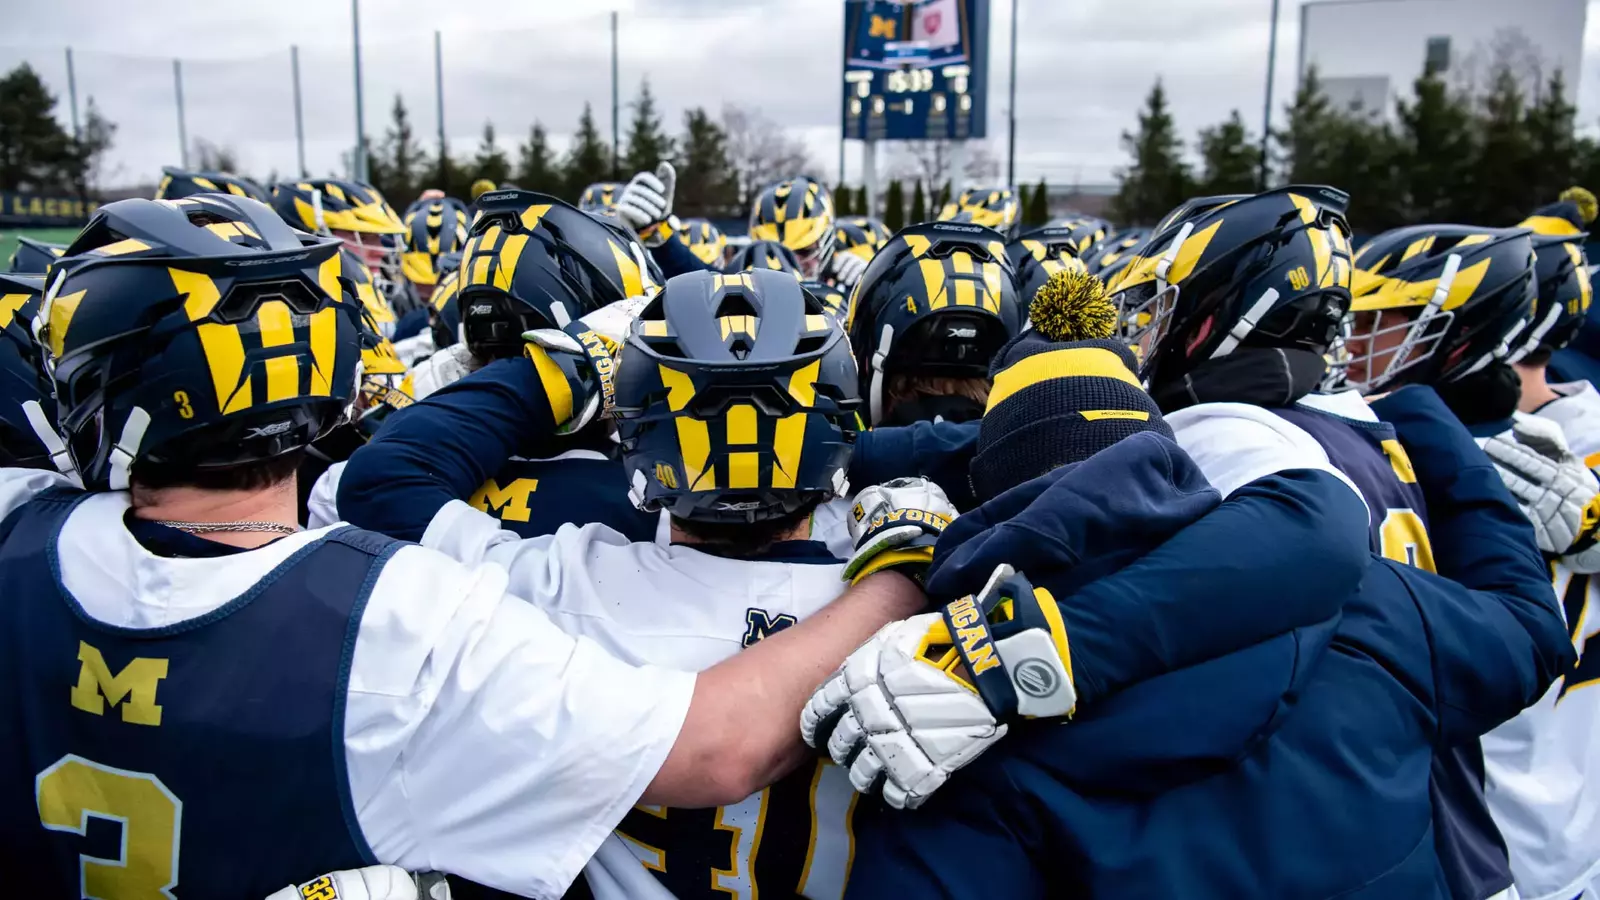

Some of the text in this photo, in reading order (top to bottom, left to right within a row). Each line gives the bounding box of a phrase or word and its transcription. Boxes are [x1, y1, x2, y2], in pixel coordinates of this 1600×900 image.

[933, 223, 983, 234] cascade
[906, 295, 918, 315] 4
[173, 390, 195, 419] 3
[655, 463, 678, 490] 40
[468, 477, 539, 522] M
[71, 640, 169, 726] M
[36, 753, 183, 900] 3
